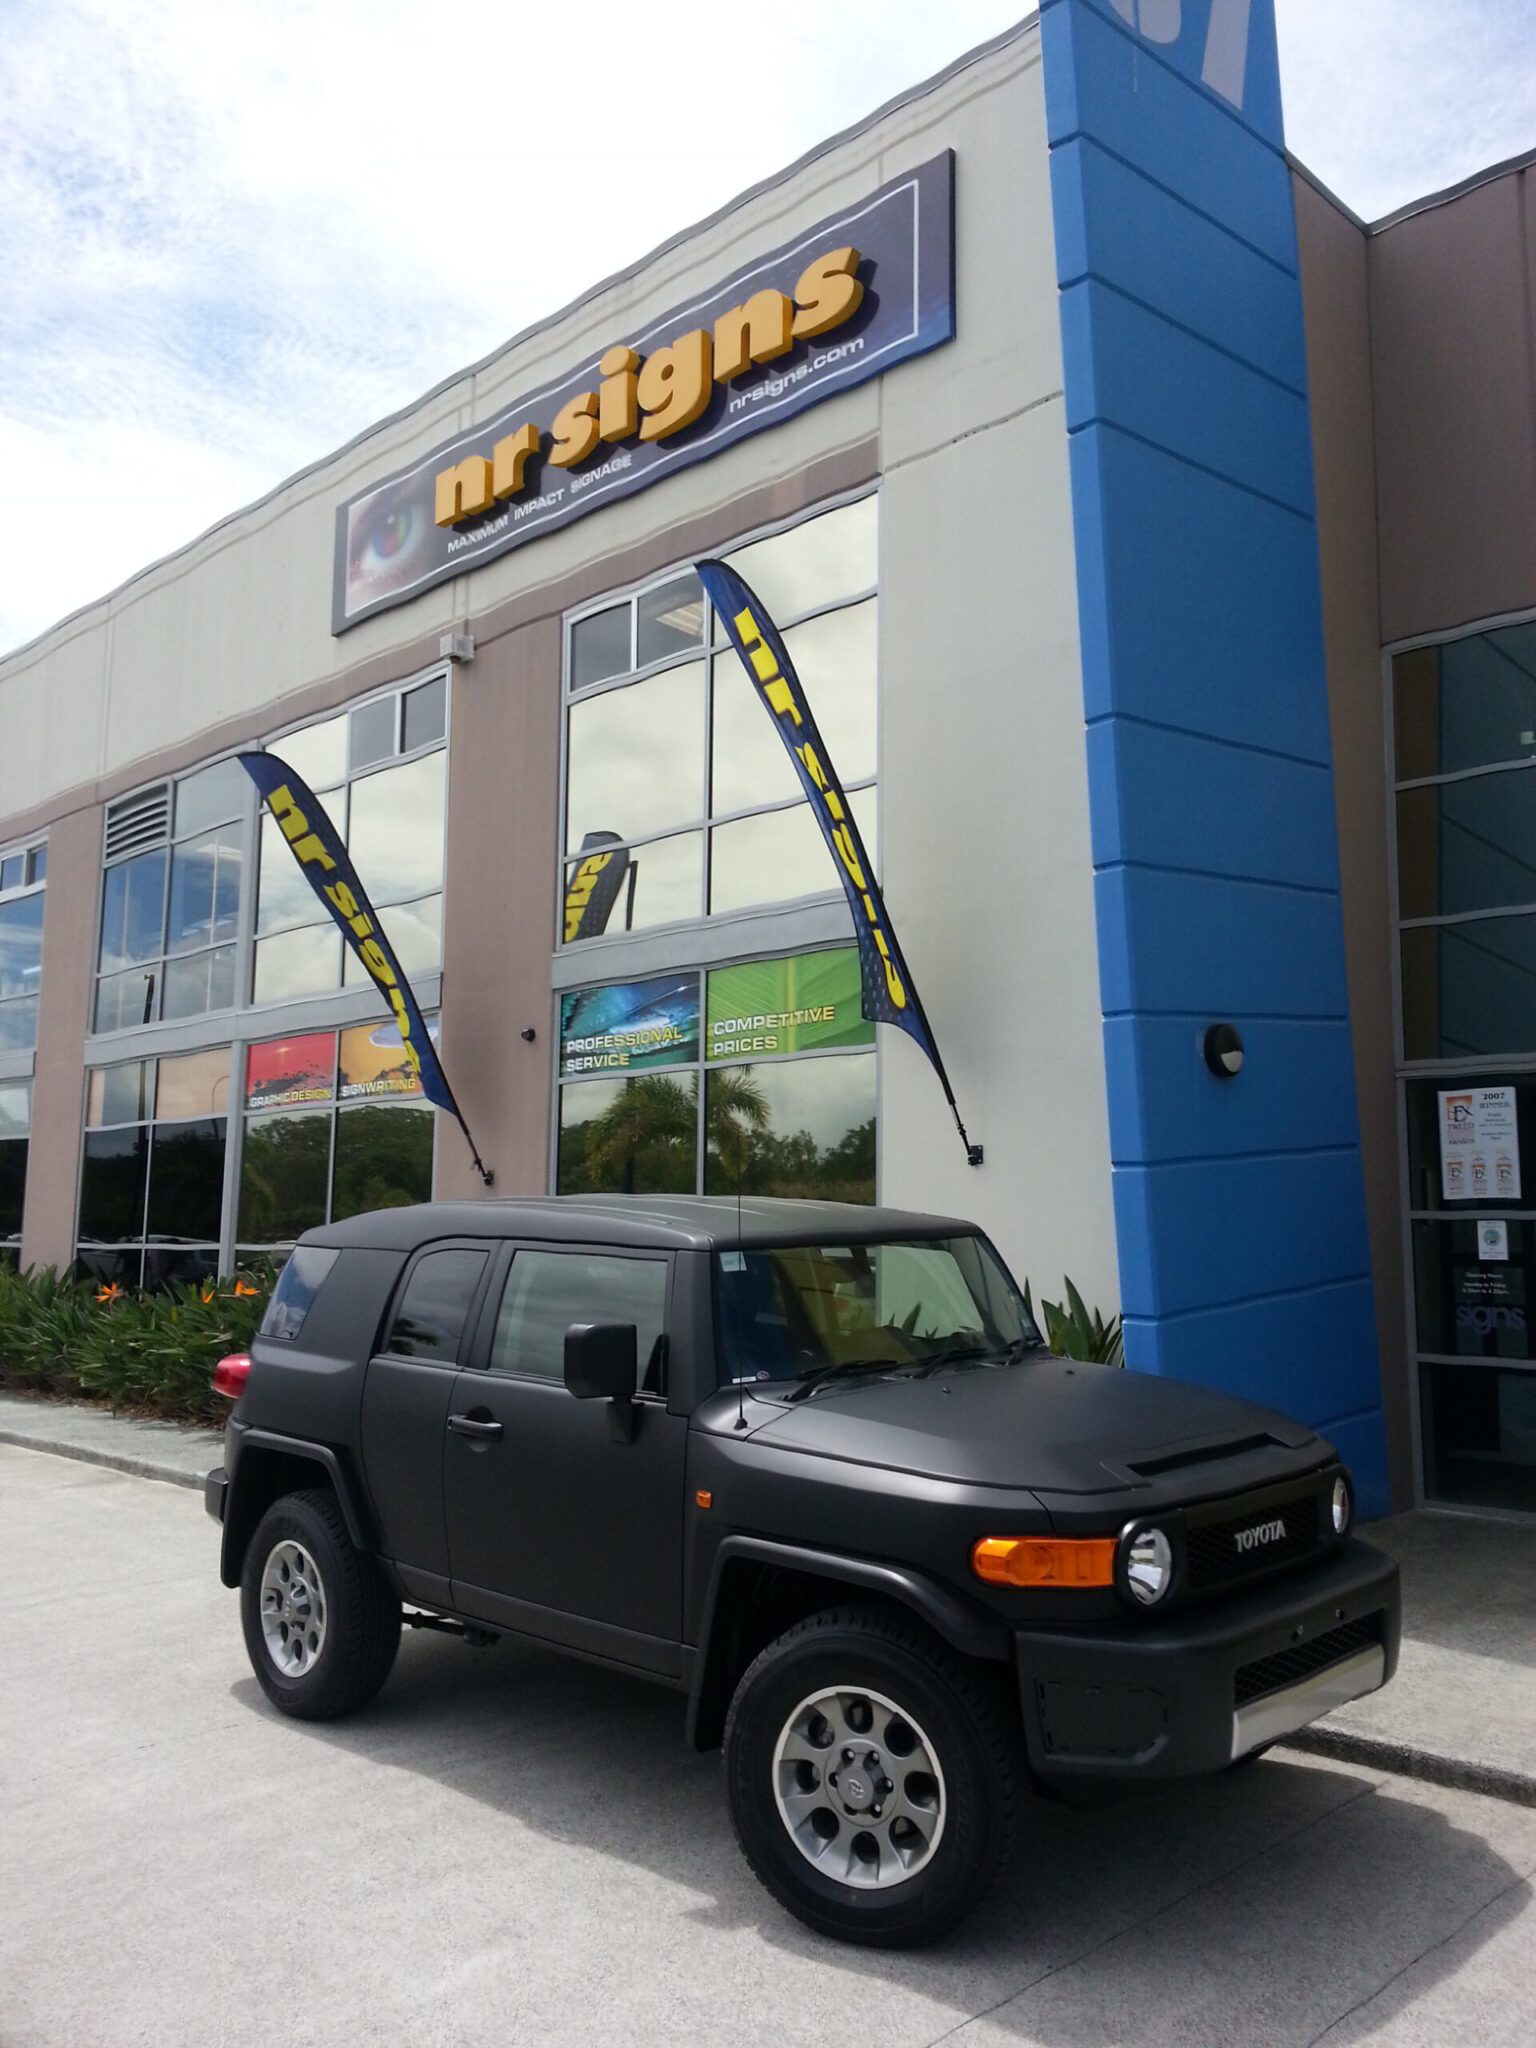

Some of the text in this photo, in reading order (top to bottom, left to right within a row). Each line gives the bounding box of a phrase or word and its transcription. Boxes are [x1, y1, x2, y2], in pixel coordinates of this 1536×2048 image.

[435, 246, 864, 528] nr signs
[729, 337, 865, 413] nrsigns.com
[447, 454, 632, 553] MAXIMUM IMPACT SIGNAGE
[734, 606, 802, 726] nr
[268, 784, 337, 871] nr
[714, 1006, 835, 1035] COMPETITIVE
[566, 1026, 682, 1053] PROFESSIONAL
[714, 1035, 778, 1056] PRICES
[566, 1053, 630, 1072] SERVICE
[250, 1088, 331, 1107] GRAPHIC DESIGN
[341, 1078, 416, 1097] SIGNWRITING
[1482, 1092, 1505, 1101] 2007
[1234, 1519, 1287, 1552] TOYOTA
